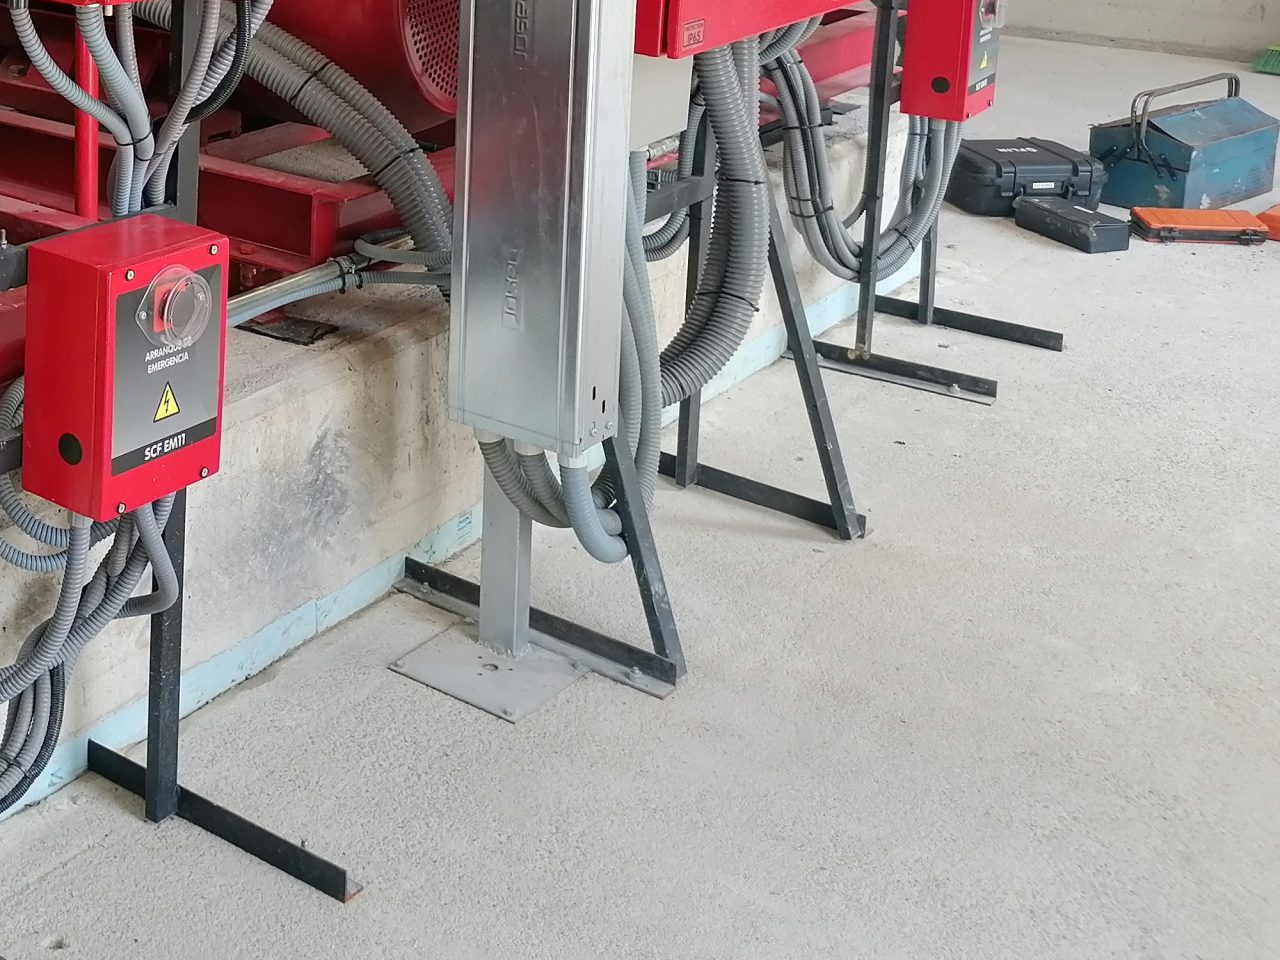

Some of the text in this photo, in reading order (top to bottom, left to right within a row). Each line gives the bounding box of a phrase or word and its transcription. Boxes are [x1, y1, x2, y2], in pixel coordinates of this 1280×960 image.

[147, 351, 190, 375] EMERGENCIA
[144, 432, 186, 461] SCF EM11
